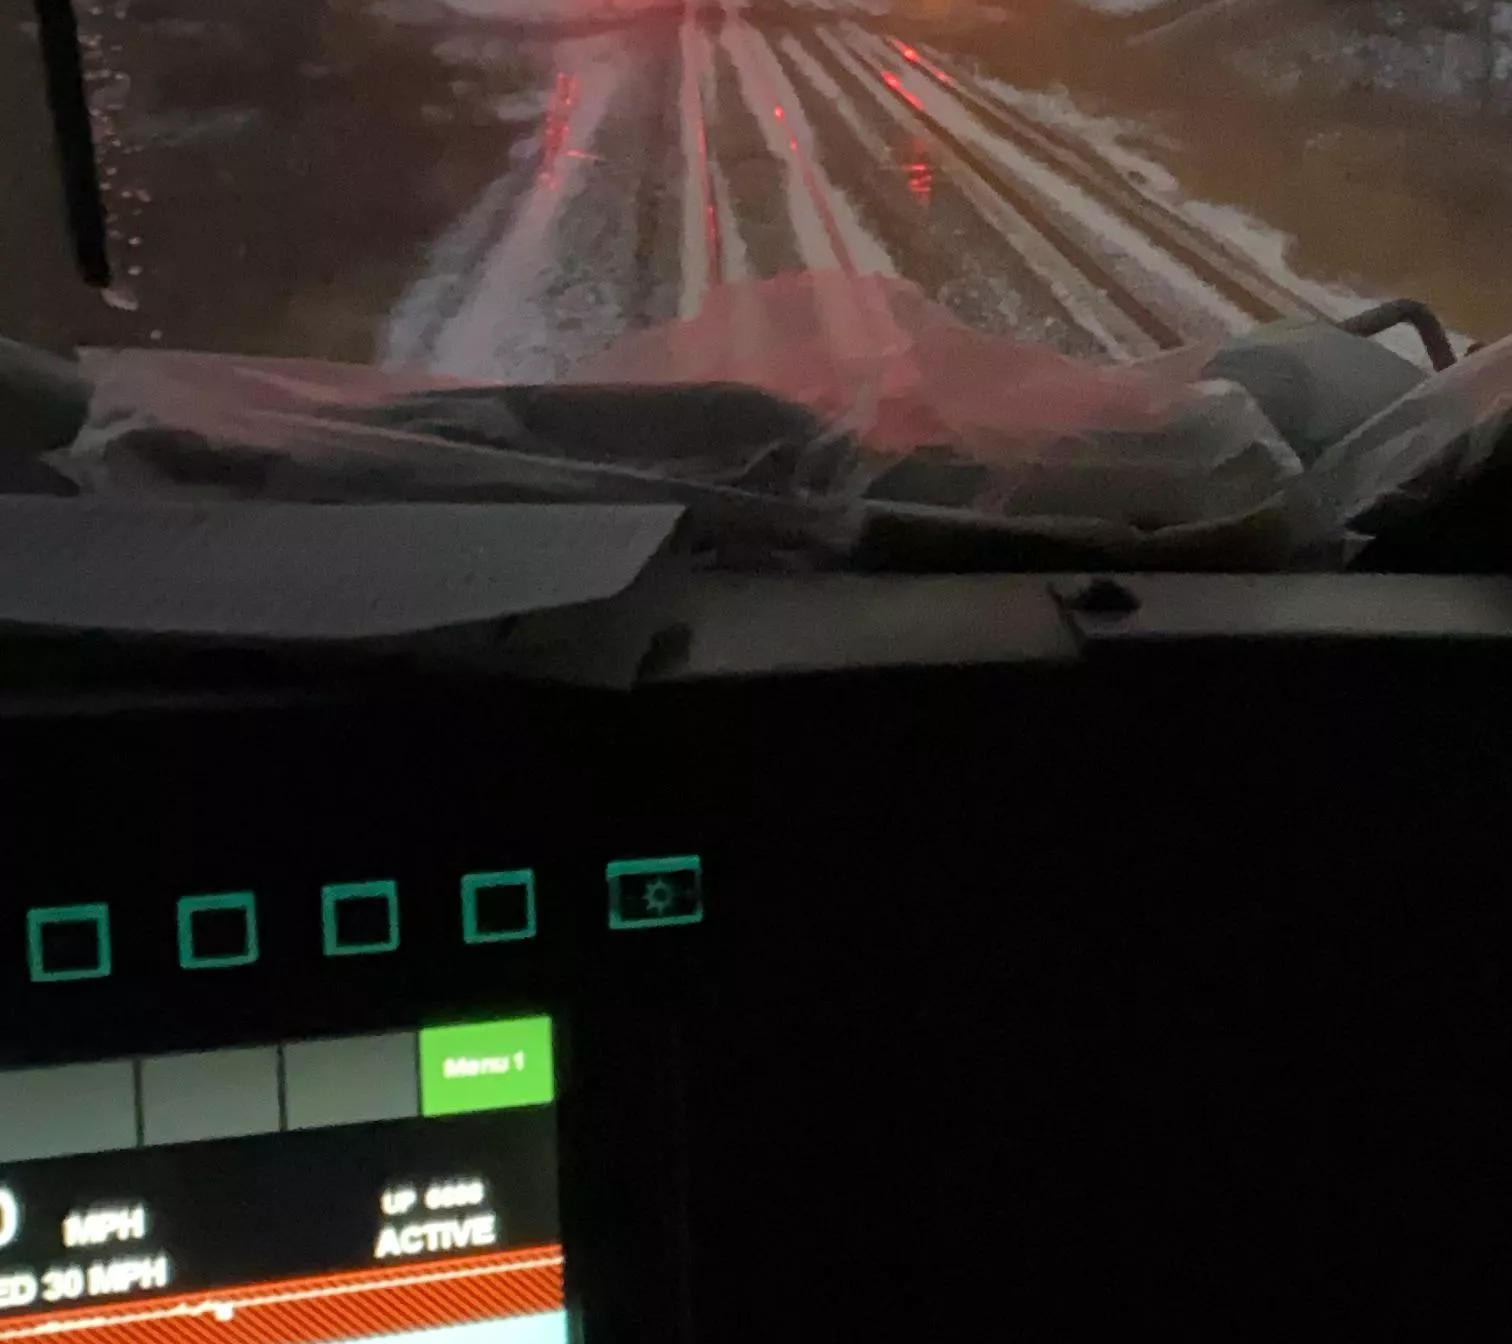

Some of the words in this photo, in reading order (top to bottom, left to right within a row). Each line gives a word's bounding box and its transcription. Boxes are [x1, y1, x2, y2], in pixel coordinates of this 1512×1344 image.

[512, 1048, 525, 1073] 1
[61, 1203, 147, 1248] MPH
[374, 1213, 496, 1259] ACTIVE
[41, 1265, 86, 1303] 30
[87, 1255, 169, 1297] MPH
